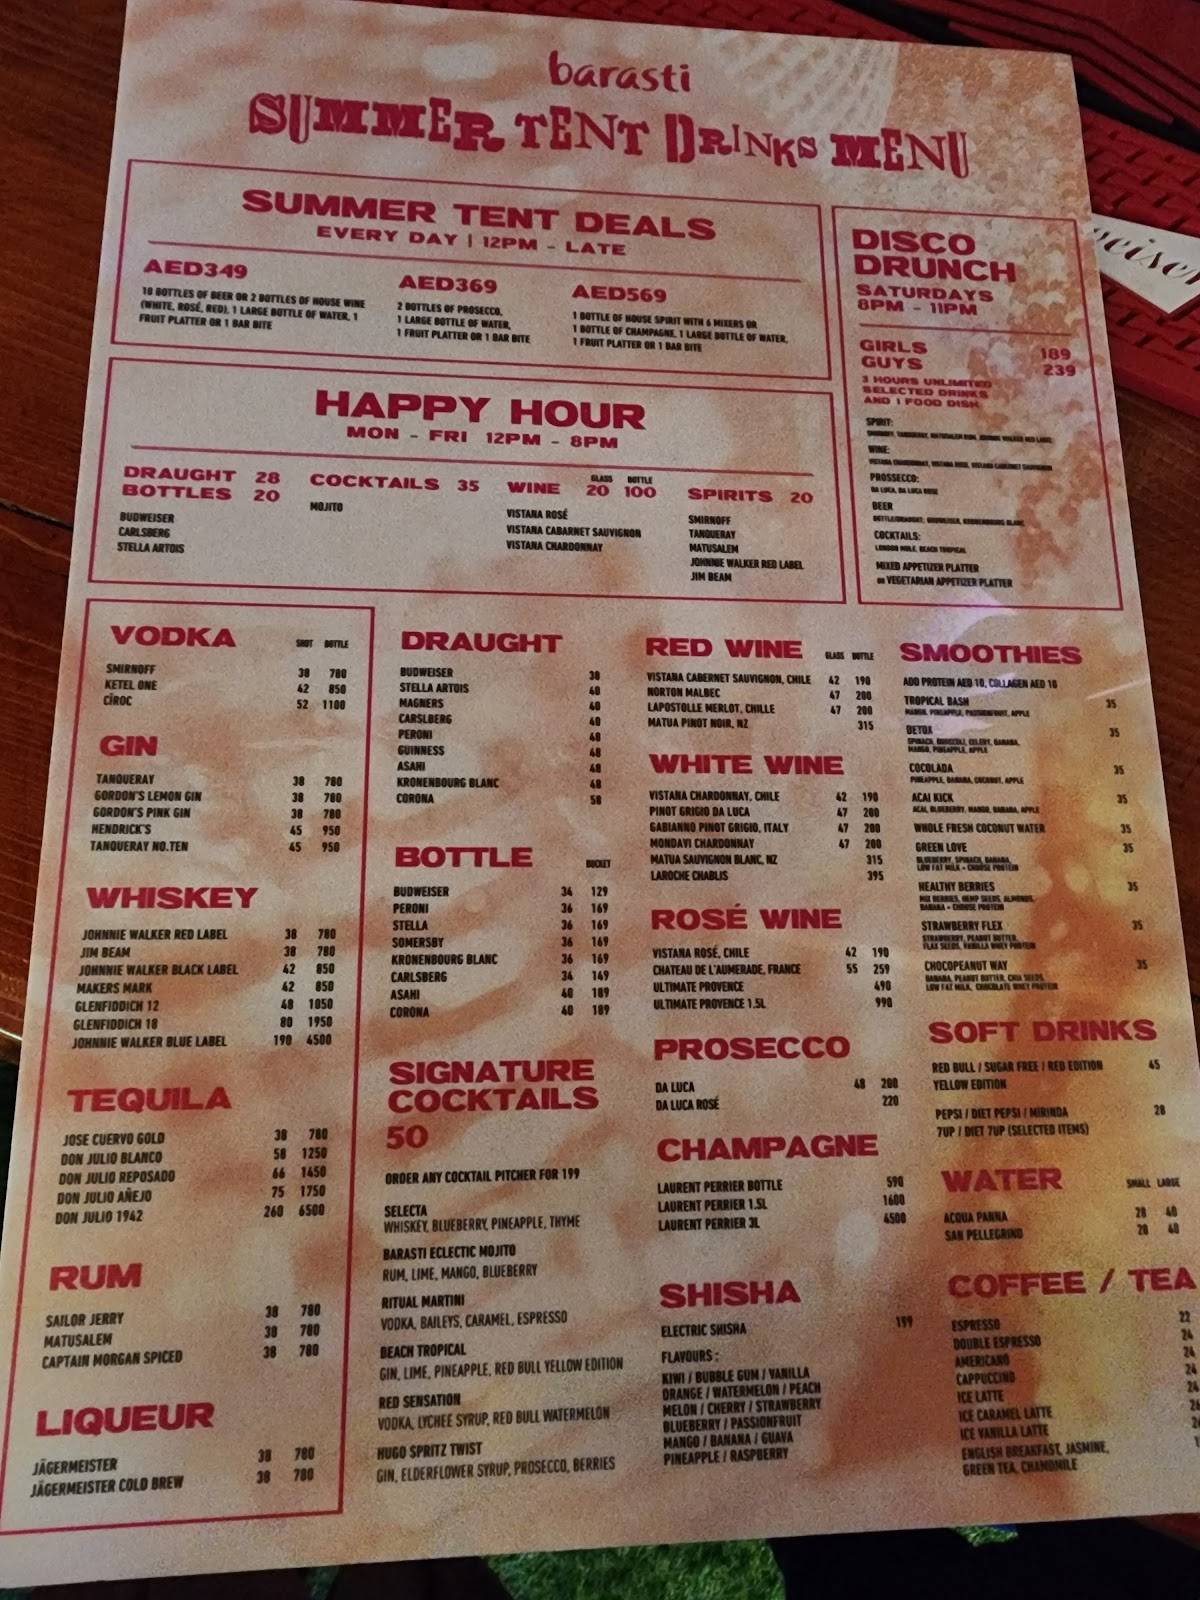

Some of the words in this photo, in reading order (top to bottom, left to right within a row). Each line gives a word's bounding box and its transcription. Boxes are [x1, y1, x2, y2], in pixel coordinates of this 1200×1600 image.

[548, 50, 690, 92] barasti
[250, 92, 505, 153] SUMMER
[515, 106, 650, 156] TENT
[665, 113, 818, 168] DRINKS
[831, 127, 970, 179] MENU
[242, 189, 436, 223] SUMMER
[453, 203, 560, 230] TENT
[575, 211, 716, 240] DEALS
[316, 225, 397, 242] EVERY
[409, 231, 457, 245] DAY
[483, 236, 537, 250] 12PM
[566, 241, 625, 255] LATE
[852, 228, 975, 255] DISCO
[143, 259, 247, 279] AED349
[854, 254, 1017, 283] DRUNCH
[398, 275, 497, 294] AED369
[572, 284, 666, 303] AED569
[856, 283, 993, 302] SATURDAYS
[857, 298, 904, 312] 8PM
[930, 302, 977, 315] 11PM
[139, 313, 165, 323] FRUIT
[168, 315, 206, 326] PLATTER
[209, 317, 221, 327] OR
[224, 318, 228, 327] 1
[232, 319, 250, 328] BAR
[252, 320, 272, 330] BITE
[859, 339, 927, 354] GIRLS
[1040, 347, 1070, 360] 189
[861, 355, 922, 370] GUYS
[1043, 363, 1076, 376] 239
[315, 389, 491, 423] HAPPY
[510, 399, 645, 430] HOUR
[346, 426, 398, 439] MON
[429, 429, 467, 442] FRI
[486, 432, 540, 445] 12PM
[570, 435, 618, 448] 8PM
[124, 466, 236, 482] DRAUGHT
[255, 471, 280, 484] 28
[310, 473, 439, 490] COCKTAILS
[457, 479, 479, 492] 35
[122, 484, 232, 500] BOTTLES
[253, 489, 280, 502] 20
[507, 481, 560, 494] WINE
[586, 484, 609, 496] 20
[624, 486, 656, 498] 100
[688, 487, 773, 502] SPIRITS
[790, 491, 813, 504] 20
[310, 501, 343, 512] MOJITO
[506, 508, 543, 518] VISTANA
[545, 508, 568, 520] ROSÉ
[872, 501, 893, 510] BEER
[120, 512, 174, 523] BUDWEISER
[688, 514, 730, 525] SMIRNOFF
[118, 526, 170, 538] CARLSBERG
[874, 530, 920, 540] COCKTAILS:
[117, 542, 150, 552] STELLA
[152, 543, 184, 553] ARTOIS
[690, 571, 705, 581] JIM
[708, 572, 732, 581] BEAM
[110, 625, 236, 647] VODKA
[401, 631, 563, 653] DRAUGHT
[646, 637, 712, 656] RED
[724, 639, 802, 658] WINE
[899, 642, 1082, 664] SMOOTHIES
[104, 679, 135, 690] KETEL
[137, 680, 157, 690] ONE
[297, 683, 309, 693] 42
[328, 683, 346, 694] 850
[648, 717, 678, 727] MATUA
[681, 718, 707, 728] PINOT
[710, 718, 734, 728] NOIR,
[736, 718, 748, 728] NZ
[858, 720, 874, 730] 315
[99, 735, 158, 756] GIN
[648, 754, 752, 774] WHITE
[763, 755, 844, 775] WINE
[909, 762, 953, 773] COCOLADA
[90, 840, 149, 851] TANQUERAY
[152, 840, 188, 852] NO.TEN
[288, 841, 302, 852] 45
[322, 841, 340, 852] 950
[915, 842, 944, 852] GREEN
[946, 842, 967, 852] LOVE
[395, 846, 532, 868] BOTTLE
[86, 886, 258, 909] WHISKEY
[393, 903, 428, 914] PERONI
[561, 902, 572, 913] 36
[591, 902, 608, 913] 169
[651, 903, 747, 930] ROSÉ
[759, 908, 842, 929] WINE
[392, 920, 428, 931] STELLA
[561, 919, 573, 930] 36
[592, 919, 608, 930] 169
[72, 1037, 117, 1049] JOHNNIE
[120, 1036, 162, 1048] WALKER
[166, 1035, 192, 1048] BLUE
[195, 1035, 227, 1047] LABEL
[274, 1034, 292, 1046] 190
[306, 1033, 332, 1045] 4500
[928, 1021, 1020, 1044] SOFT
[1032, 1019, 1157, 1041] DRINKS
[654, 1036, 850, 1060] PROSECCO
[389, 1058, 594, 1085] SIGNATURE
[655, 1082, 668, 1093] DA
[671, 1081, 695, 1092] LUCA
[933, 1079, 968, 1091] YELLOW
[971, 1078, 1006, 1090] EDITION
[66, 1086, 232, 1113] TEQUILA
[388, 1086, 599, 1113] COCKTAILS
[386, 1124, 428, 1150] 50
[657, 1134, 878, 1162] CHAMPAGNE
[657, 1181, 701, 1194] LAURENT
[704, 1180, 744, 1192] PERRIER
[747, 1179, 783, 1191] BOTTLE
[886, 1175, 904, 1188] 590
[940, 1166, 1063, 1192] WATER
[55, 1211, 78, 1224] DON
[81, 1210, 112, 1224] JULIO
[116, 1209, 143, 1222] 1942
[263, 1204, 284, 1217] 260
[298, 1203, 324, 1216] 6500
[384, 1204, 427, 1217] SELECTA
[49, 1262, 142, 1291] RUM
[382, 1268, 408, 1282] RUM,
[412, 1267, 438, 1280] LIME,
[441, 1265, 479, 1279] MANGO,
[482, 1263, 537, 1278] BLUEBERRY
[948, 1270, 1086, 1298] COFFEE
[1127, 1266, 1197, 1292] TEA
[659, 1280, 801, 1308] SHISHA
[45, 1313, 86, 1328] SAILOR
[89, 1312, 124, 1326] JERRY
[661, 1323, 707, 1338] ELECTRIC
[710, 1322, 746, 1336] SHISHA
[957, 1391, 973, 1404] ICE
[975, 1389, 1004, 1402] LATTE
[36, 1402, 214, 1436] LIQUEUR
[376, 1468, 398, 1483] GIN,
[401, 1464, 474, 1482] ELDERFLOWER
[477, 1461, 511, 1477] SYRUP,
[514, 1458, 570, 1475] PROSECCO,
[573, 1456, 615, 1472] BERRIES
